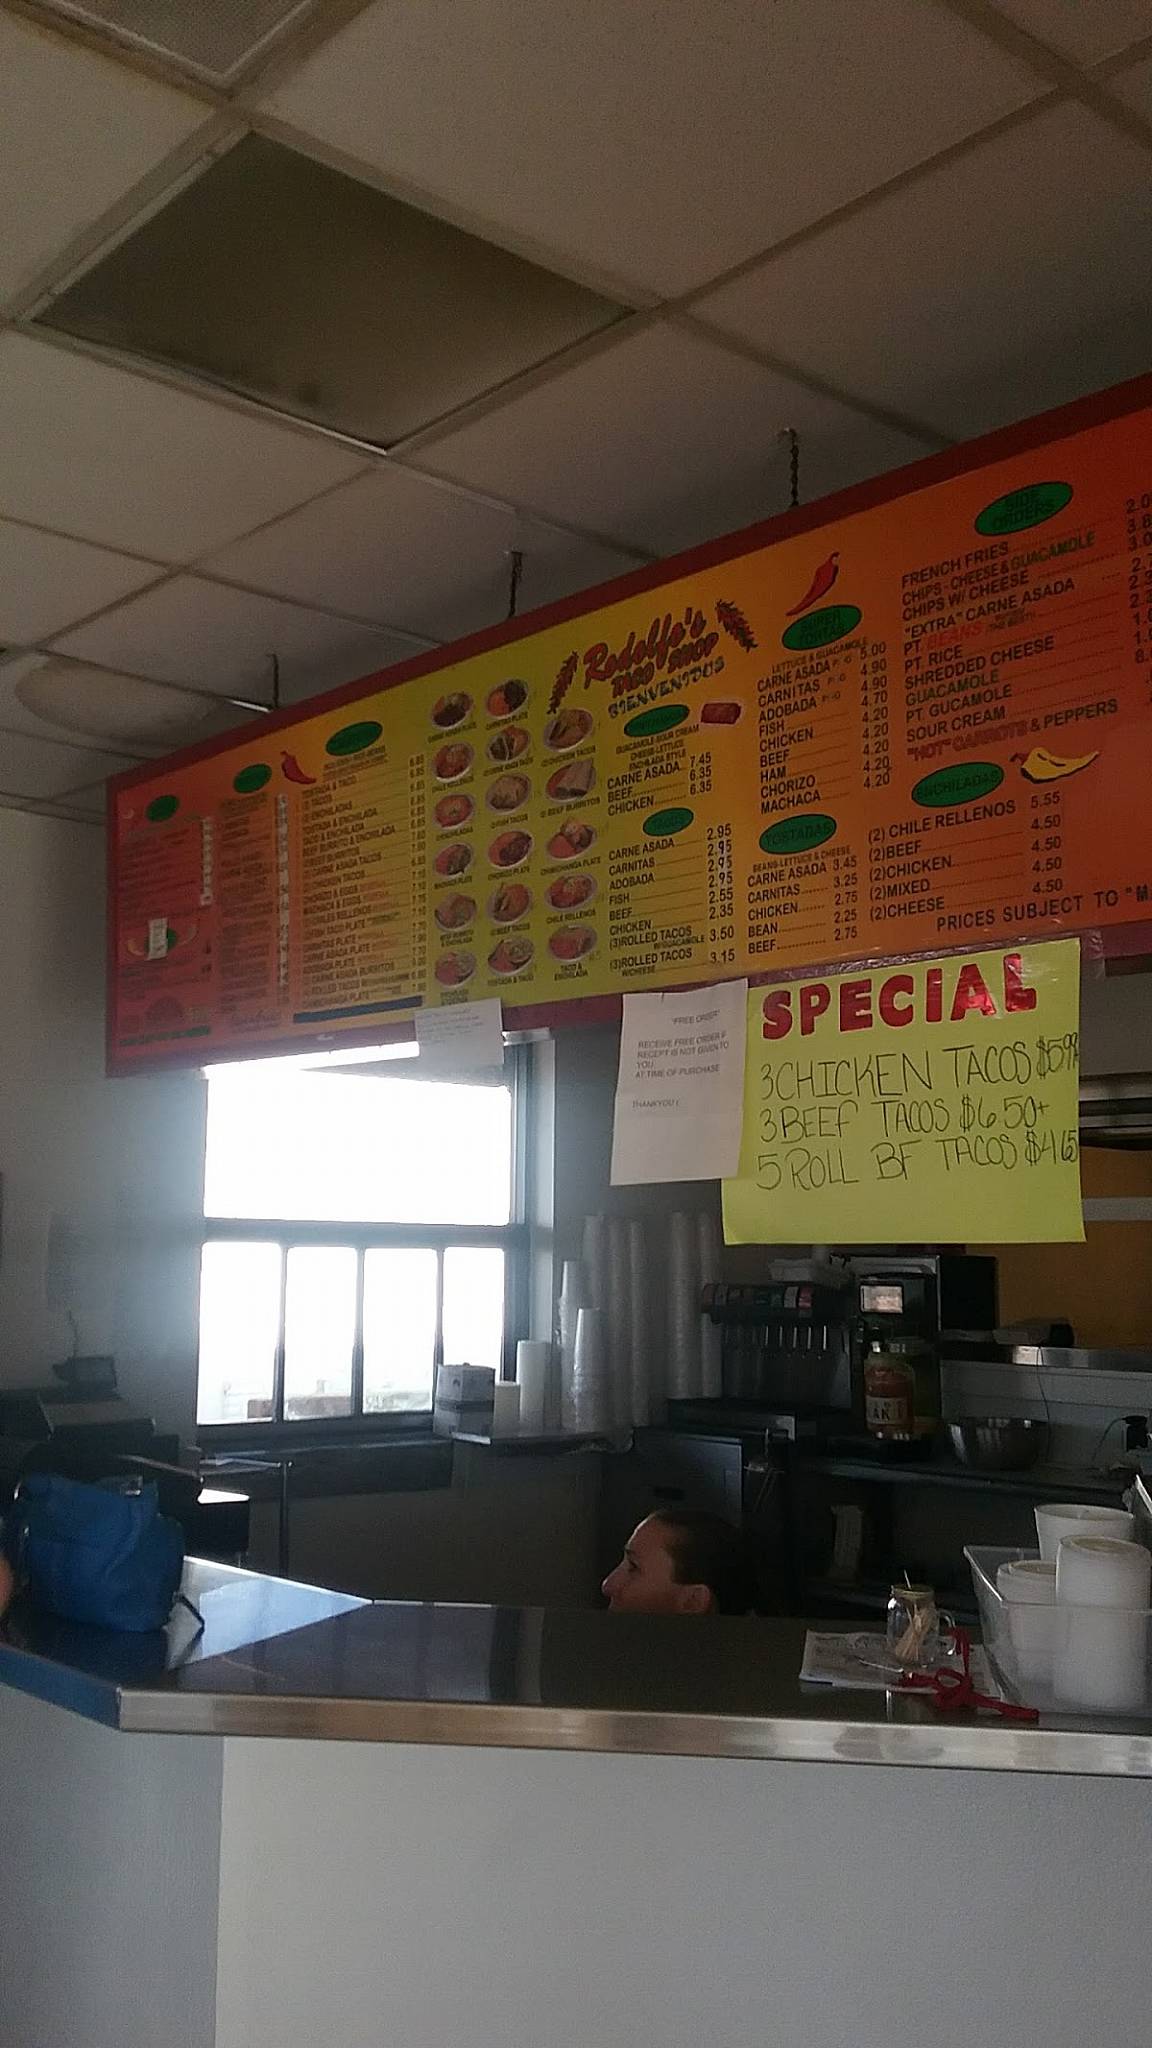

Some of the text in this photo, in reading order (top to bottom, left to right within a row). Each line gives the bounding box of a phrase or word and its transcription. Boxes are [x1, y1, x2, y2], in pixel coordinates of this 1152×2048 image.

[902, 557, 961, 589] FRENCH
[964, 541, 1009, 570] FRIES
[902, 582, 942, 607] CHIPS
[950, 561, 1000, 591] CHEESE
[1000, 560, 1010, 575] &
[1010, 531, 1095, 571] GUACAMOLE
[902, 596, 945, 622] CHIPS
[969, 570, 1029, 600] CHEESE
[965, 595, 1018, 621] CARNE
[1023, 577, 1075, 605] ASADA
[584, 607, 706, 689] Rodolfo's
[611, 632, 719, 698] TACO SHOP
[904, 639, 921, 656] PT
[904, 644, 963, 674] PT RICE
[904, 635, 1054, 690] SHREDDED CHEESE
[757, 671, 792, 692] CARNE
[795, 660, 831, 681] ASADA
[860, 641, 886, 660] 5.00
[861, 658, 887, 676] 4.90
[608, 656, 725, 718] BIENVENIDOS
[759, 696, 817, 723] ADOBADA
[861, 675, 887, 691] 4.90
[905, 668, 999, 706] GUACAMOLE
[906, 684, 1012, 724] PT GUCAMOLE
[759, 691, 888, 737] FISH 4.70
[760, 706, 888, 753] CHICKEN 4.20
[906, 706, 1006, 743] SOUR CREAM
[1030, 718, 1041, 733] &
[1044, 698, 1119, 730] PEPPERS
[760, 722, 889, 768] BEEF 4.20
[760, 739, 889, 783] HAM 4.20
[607, 752, 712, 790] CARNE ASADA 7.45
[607, 766, 712, 802] BEEF 6.35
[760, 755, 890, 799] CHORIZO 4.20
[608, 796, 654, 816] CHICKEN
[689, 782, 712, 795] 6.35
[761, 772, 890, 815] MACHACA 4.20
[868, 791, 1060, 845] (2) CHILE RELLENOS 5.55
[1031, 814, 1061, 831] 4.50
[608, 823, 731, 861] CARNE ASADA 2.95
[608, 839, 732, 876] CARNITAS 2.95
[1031, 836, 1062, 853] 4.50
[609, 855, 732, 891] ADOBADA 2.95
[747, 856, 857, 888] CARNE ASADA 3.45
[1032, 857, 1062, 874] 4.50
[609, 871, 733, 906] FISH 2.95
[748, 874, 858, 904] CARNITAS 3.25
[1032, 878, 1063, 895] 4.50
[609, 907, 633, 921] BEEF
[609, 903, 734, 936] CHICKEN 2.35
[748, 891, 858, 921] CHICKEN 2.75
[748, 909, 858, 938] BEAN 2.25
[936, 909, 995, 932] PRICES
[1002, 895, 1084, 923] SUBJECT
[1093, 889, 1119, 908] TO
[660, 925, 692, 940] TACOS
[710, 925, 734, 942] 3.50
[748, 926, 858, 954] BEEF 2.75
[660, 948, 692, 962] TACOS
[710, 948, 735, 964] 3.15
[762, 953, 1037, 1040] SPECIAL
[674, 1037, 694, 1047] FREE
[679, 1046, 696, 1056] NOT
[719, 1041, 729, 1051] TO
[635, 1064, 720, 1079] AT TIME OF PURCHASE
[636, 1060, 654, 1070] YOU
[942, 1041, 1031, 1088] TACOS
[871, 1098, 953, 1137] TACOS
[871, 1140, 922, 1180] BF
[936, 1134, 1017, 1170] TACOS
